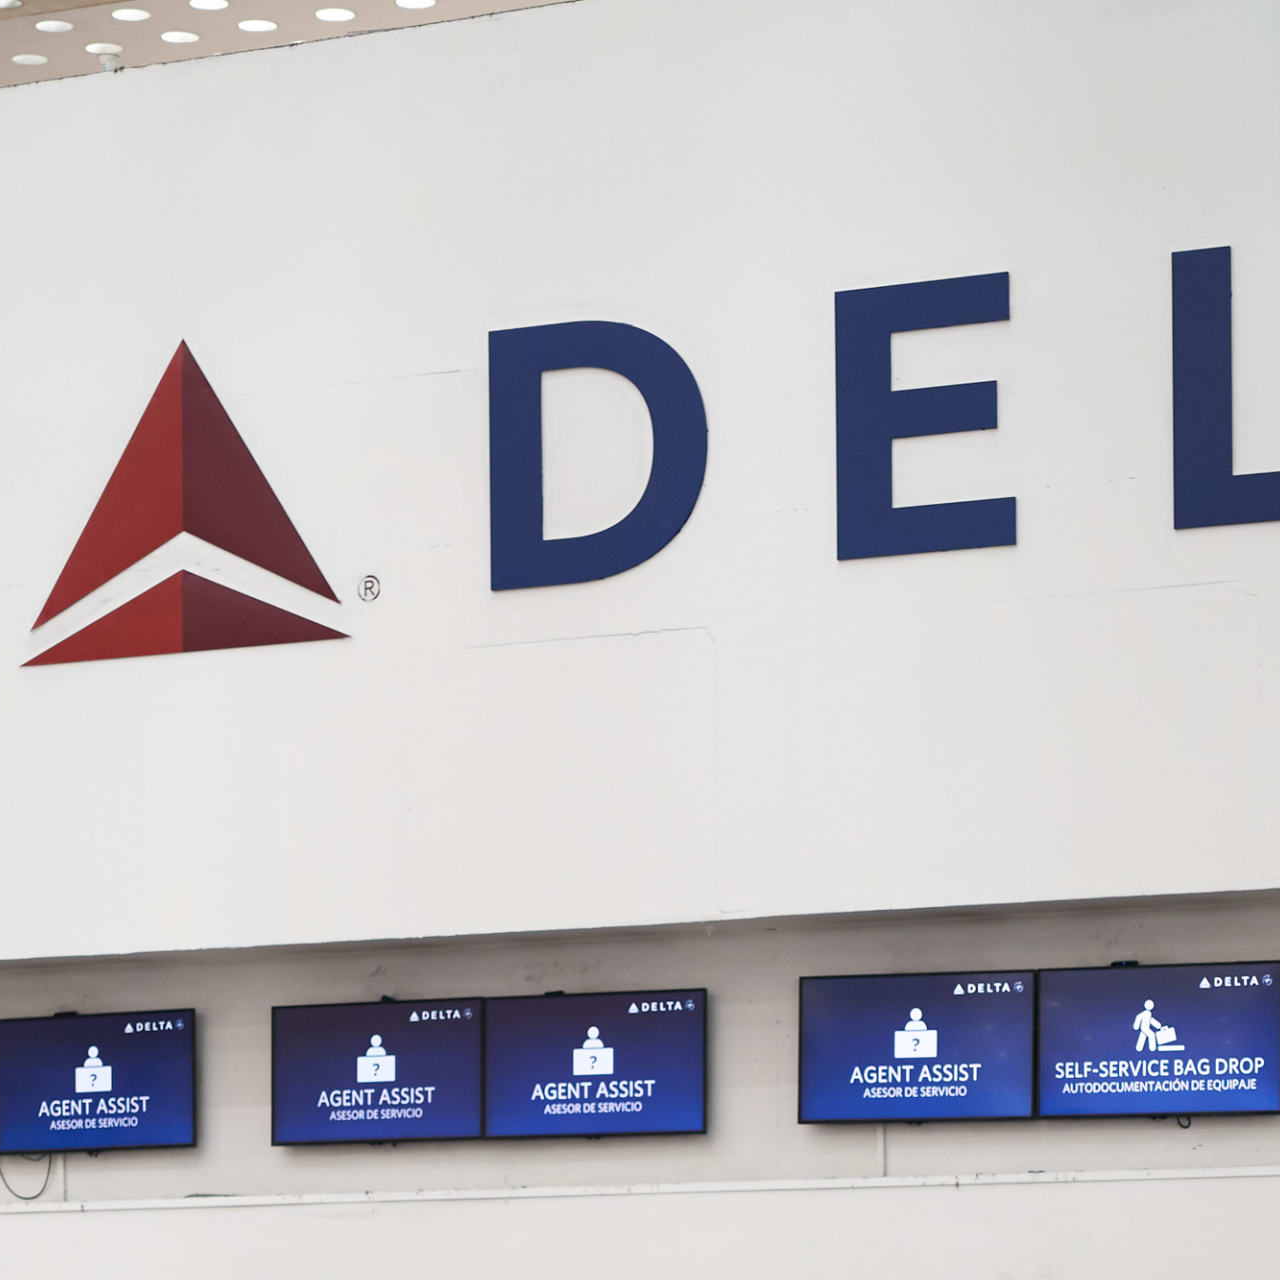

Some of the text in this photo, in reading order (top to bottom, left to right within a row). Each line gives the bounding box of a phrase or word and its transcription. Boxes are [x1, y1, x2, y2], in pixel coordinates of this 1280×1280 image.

[967, 982, 1011, 994] DELTA
[1214, 975, 1258, 987] DELTA
[641, 1001, 682, 1013] DELTA
[421, 1009, 461, 1021] DELTA
[136, 1021, 173, 1033] DELTA
[850, 1063, 981, 1084] AGENT ASSIST
[1055, 1057, 1265, 1079] SELF-SERVICE BAG DROP
[531, 1080, 655, 1101] AGENT ASSIST
[863, 1085, 967, 1098] ASESOR DE SERVICIO
[1062, 1078, 1257, 1094] AUTODOCUMENTACIÓN DE EQUIPAJE
[318, 1087, 435, 1108] AGENT ASSIST
[38, 1096, 150, 1117] AGENT ASSIST
[544, 1101, 642, 1115] ASESOR DE SERVICIO
[329, 1108, 423, 1121] ASESOR DE SERVICIO
[50, 1116, 138, 1130] ASESOR DE SERVICIO
